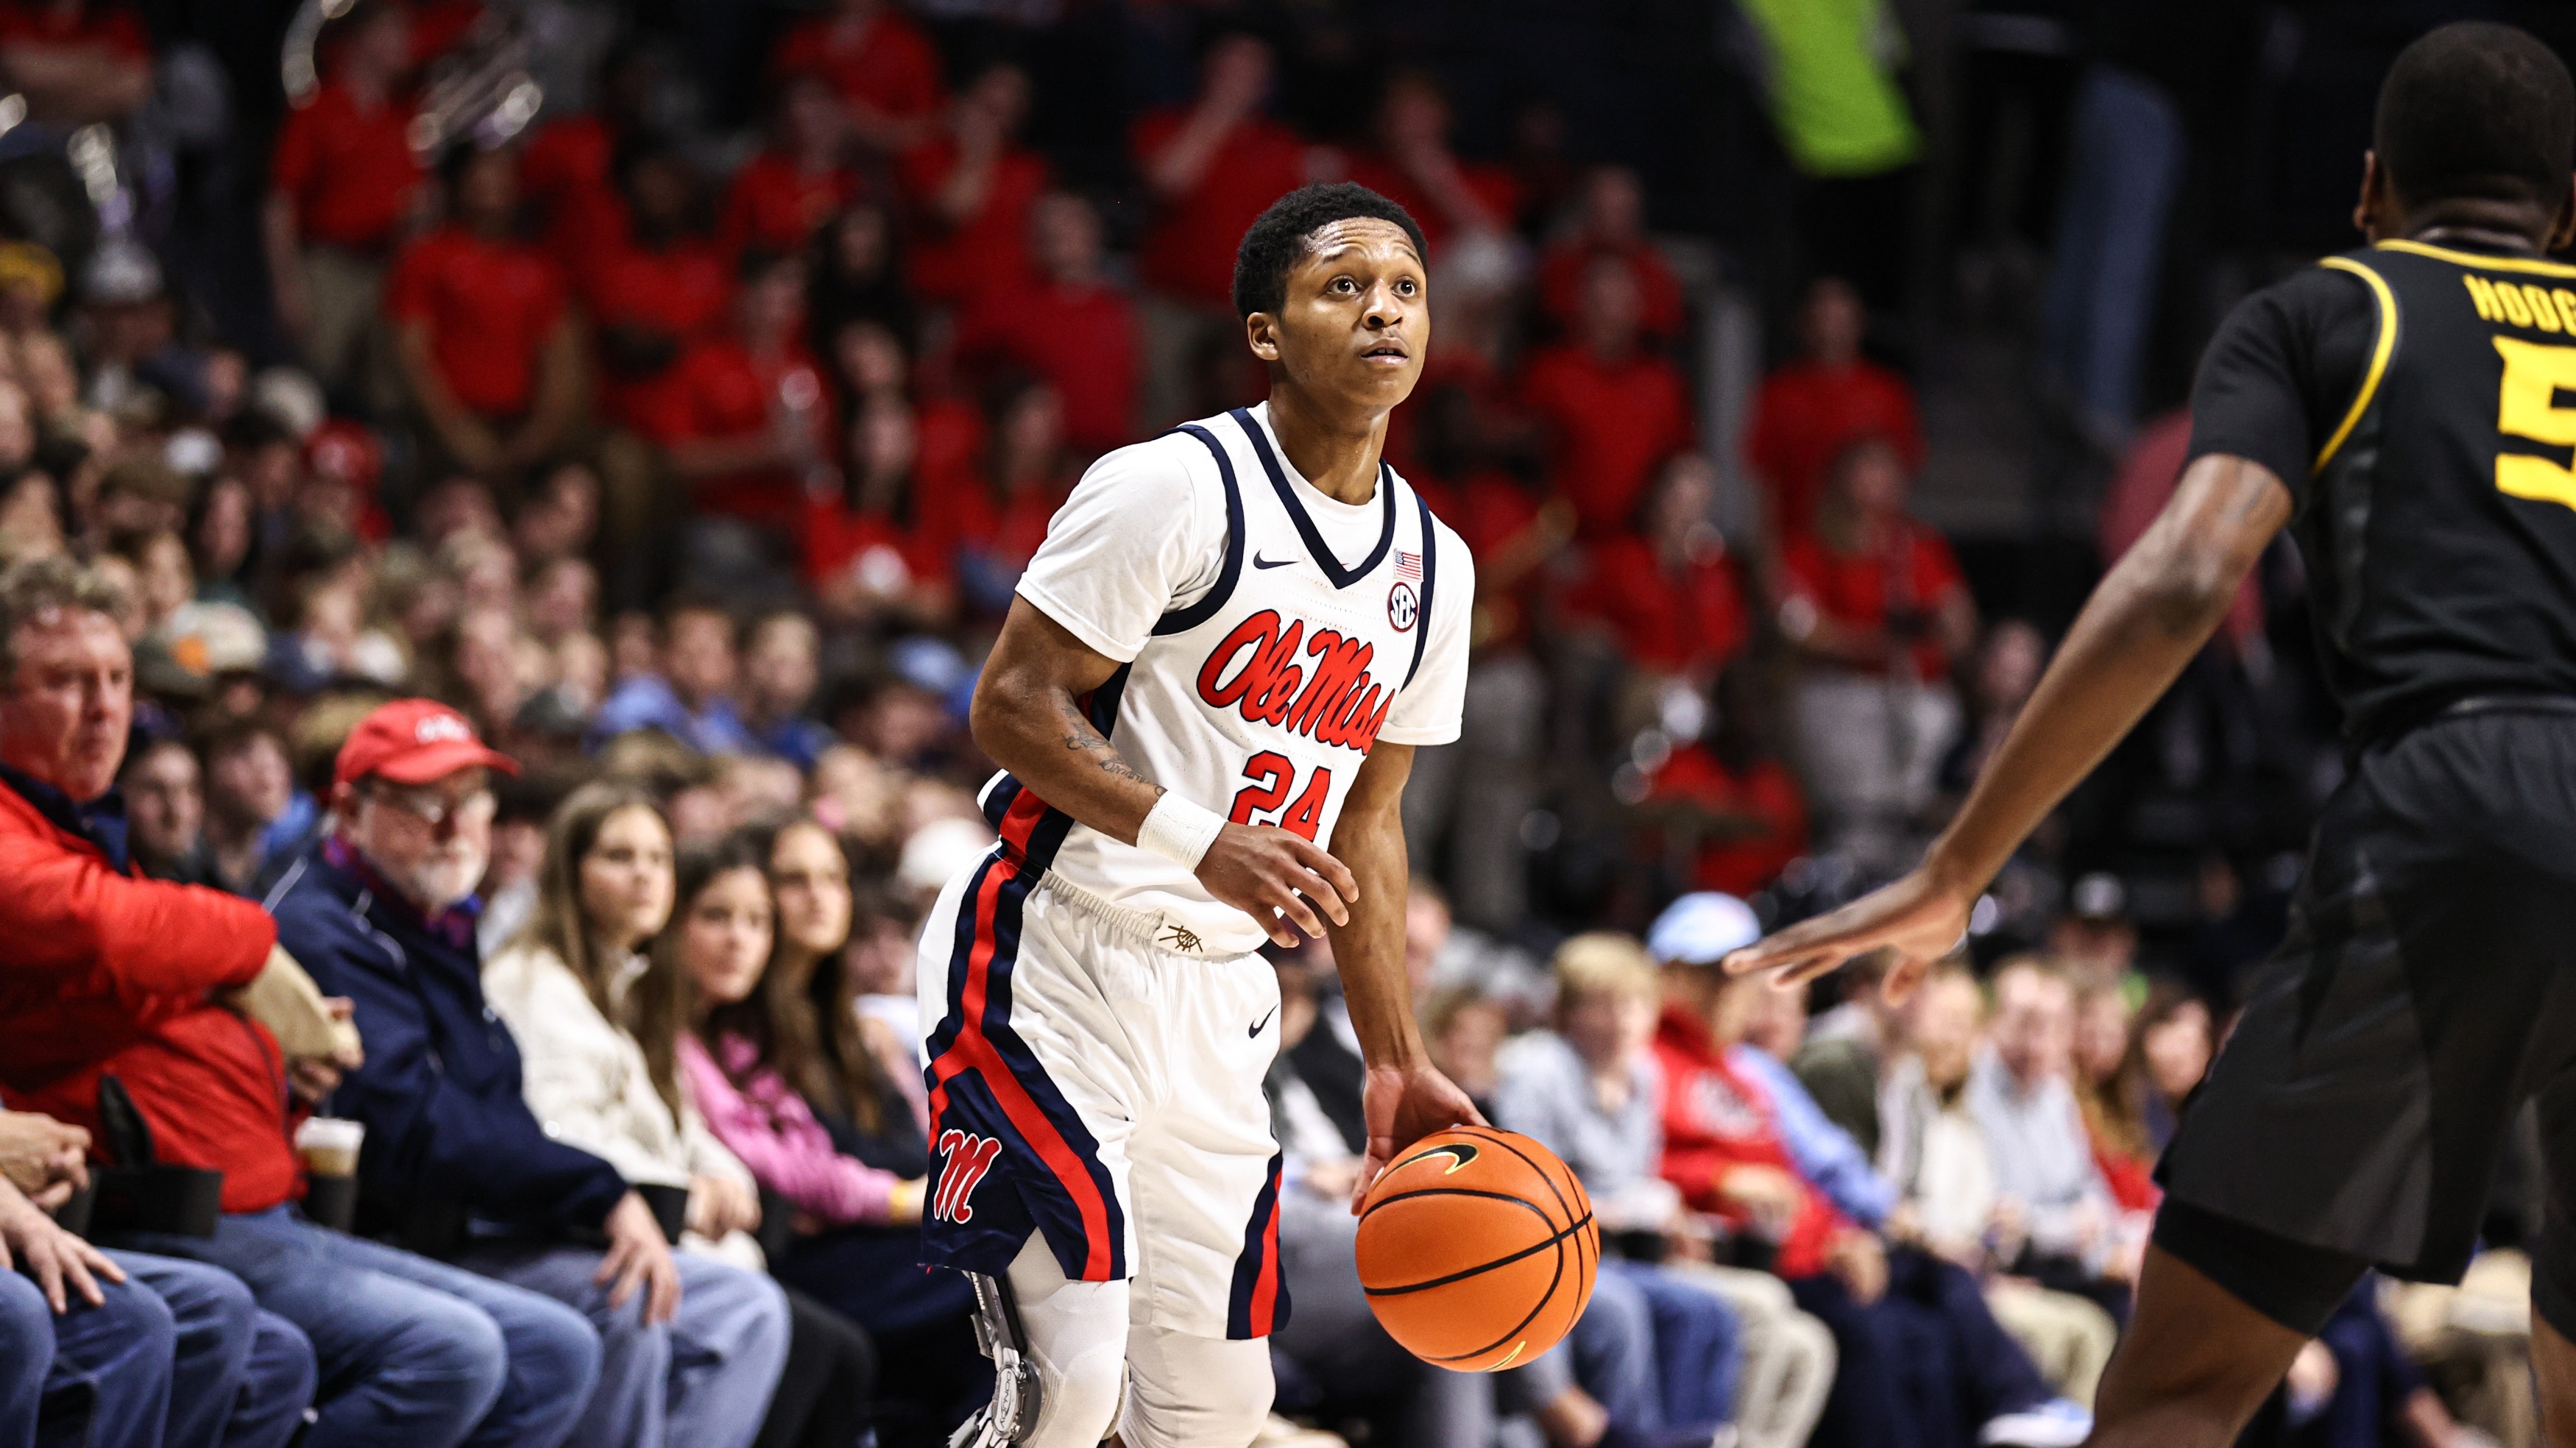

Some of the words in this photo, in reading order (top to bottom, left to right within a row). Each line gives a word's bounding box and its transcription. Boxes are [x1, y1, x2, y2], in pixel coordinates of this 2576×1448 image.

[2492, 335, 2576, 513] 5
[1390, 584, 1418, 629] SEC
[1197, 608, 1303, 727] Ole
[1287, 627, 1396, 756] Miss
[1228, 749, 1331, 842] 24
[934, 1129, 1002, 1224] M
[999, 1371, 1012, 1429] DONJOY
